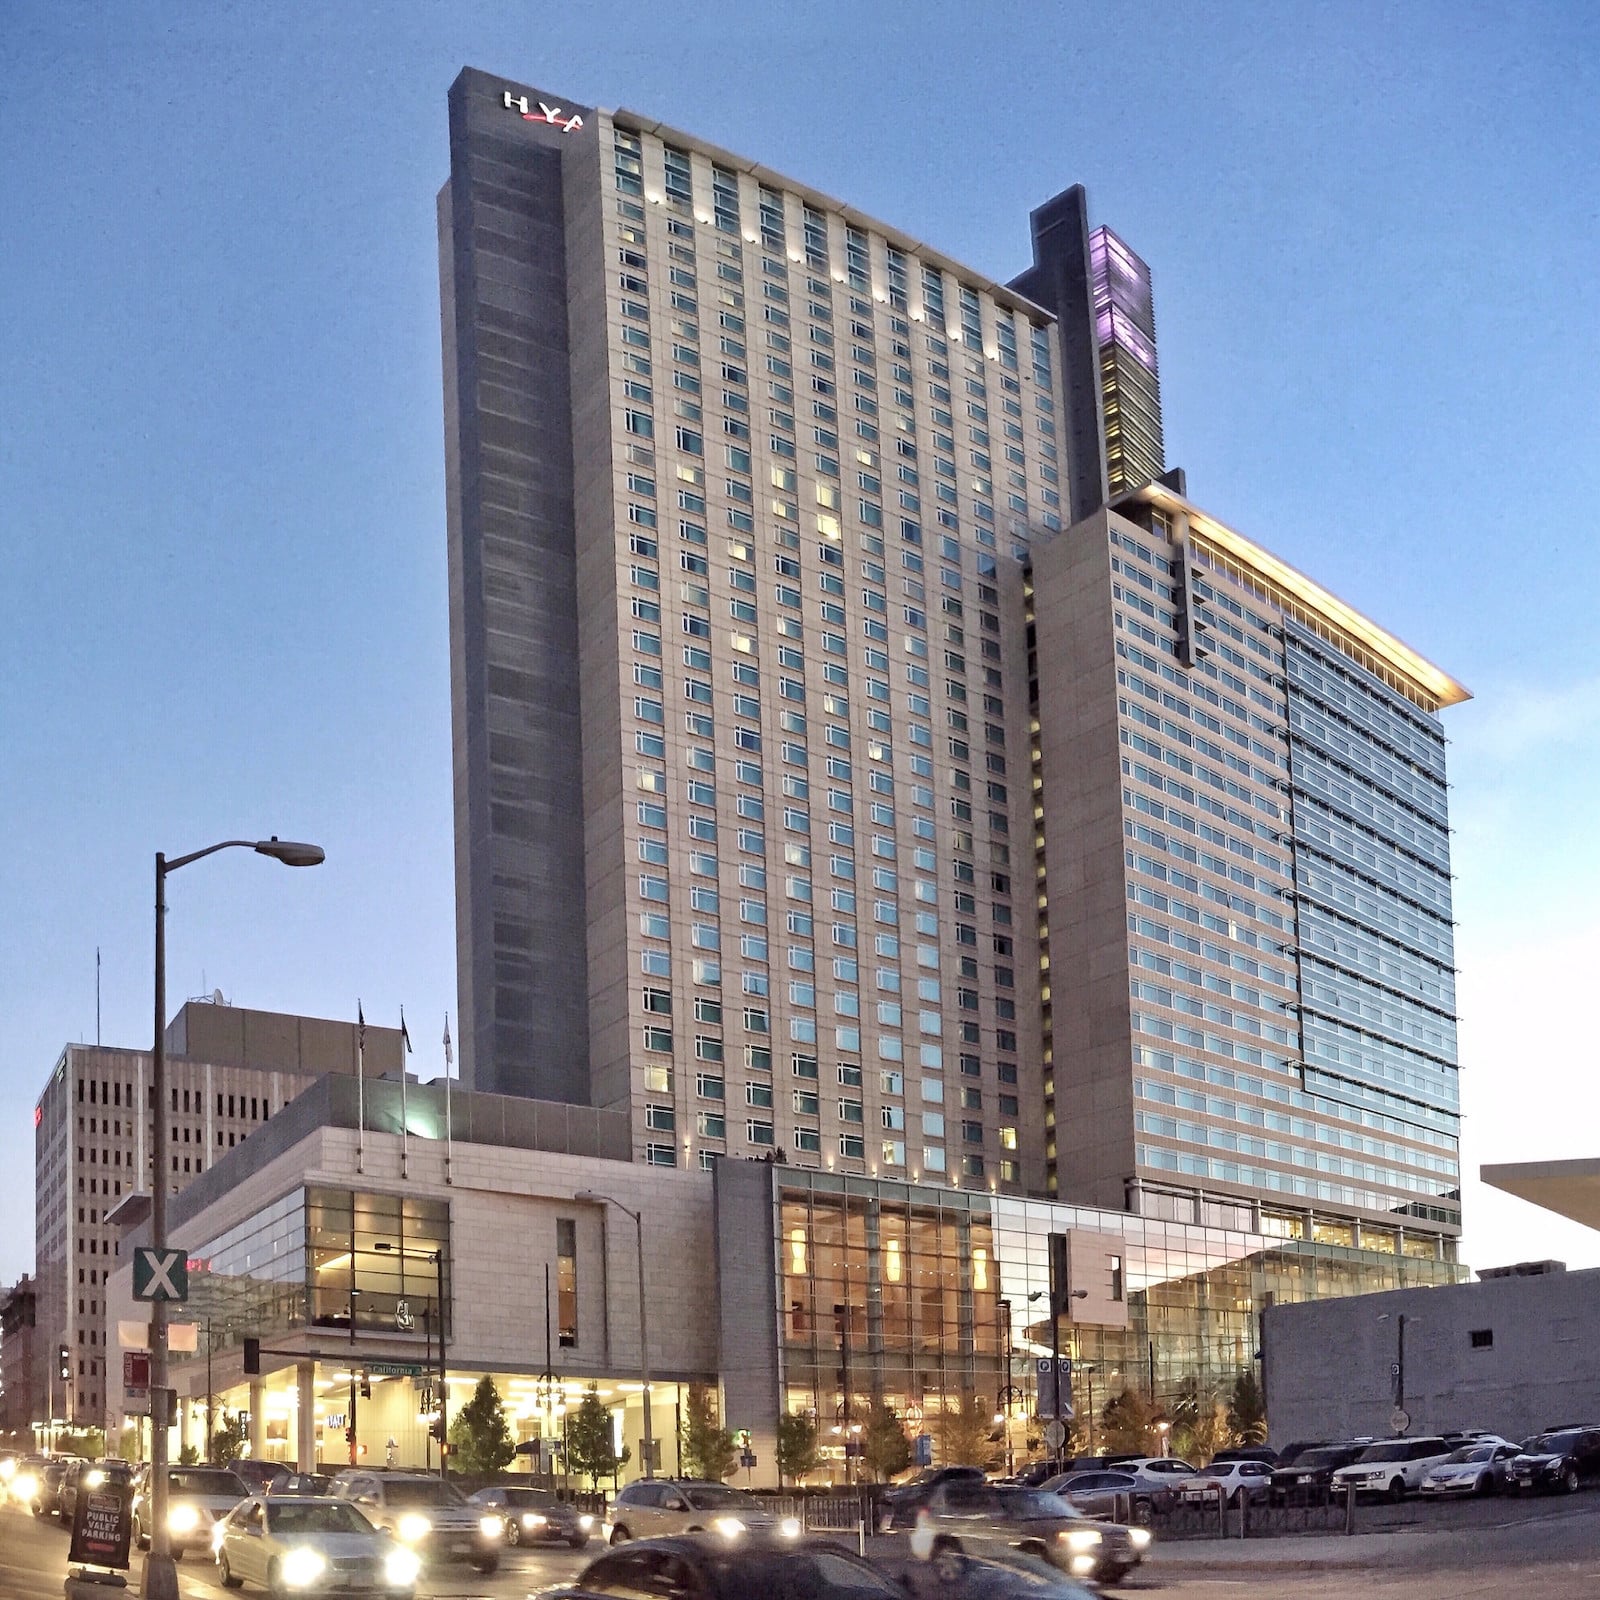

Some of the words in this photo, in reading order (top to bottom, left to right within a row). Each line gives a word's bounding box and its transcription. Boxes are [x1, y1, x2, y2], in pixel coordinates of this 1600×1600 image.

[141, 1251, 181, 1299] X
[373, 1366, 413, 1375] California
[86, 1511, 119, 1523] PUBLIC
[88, 1521, 116, 1531] VALET
[81, 1529, 120, 1541] PARKING
